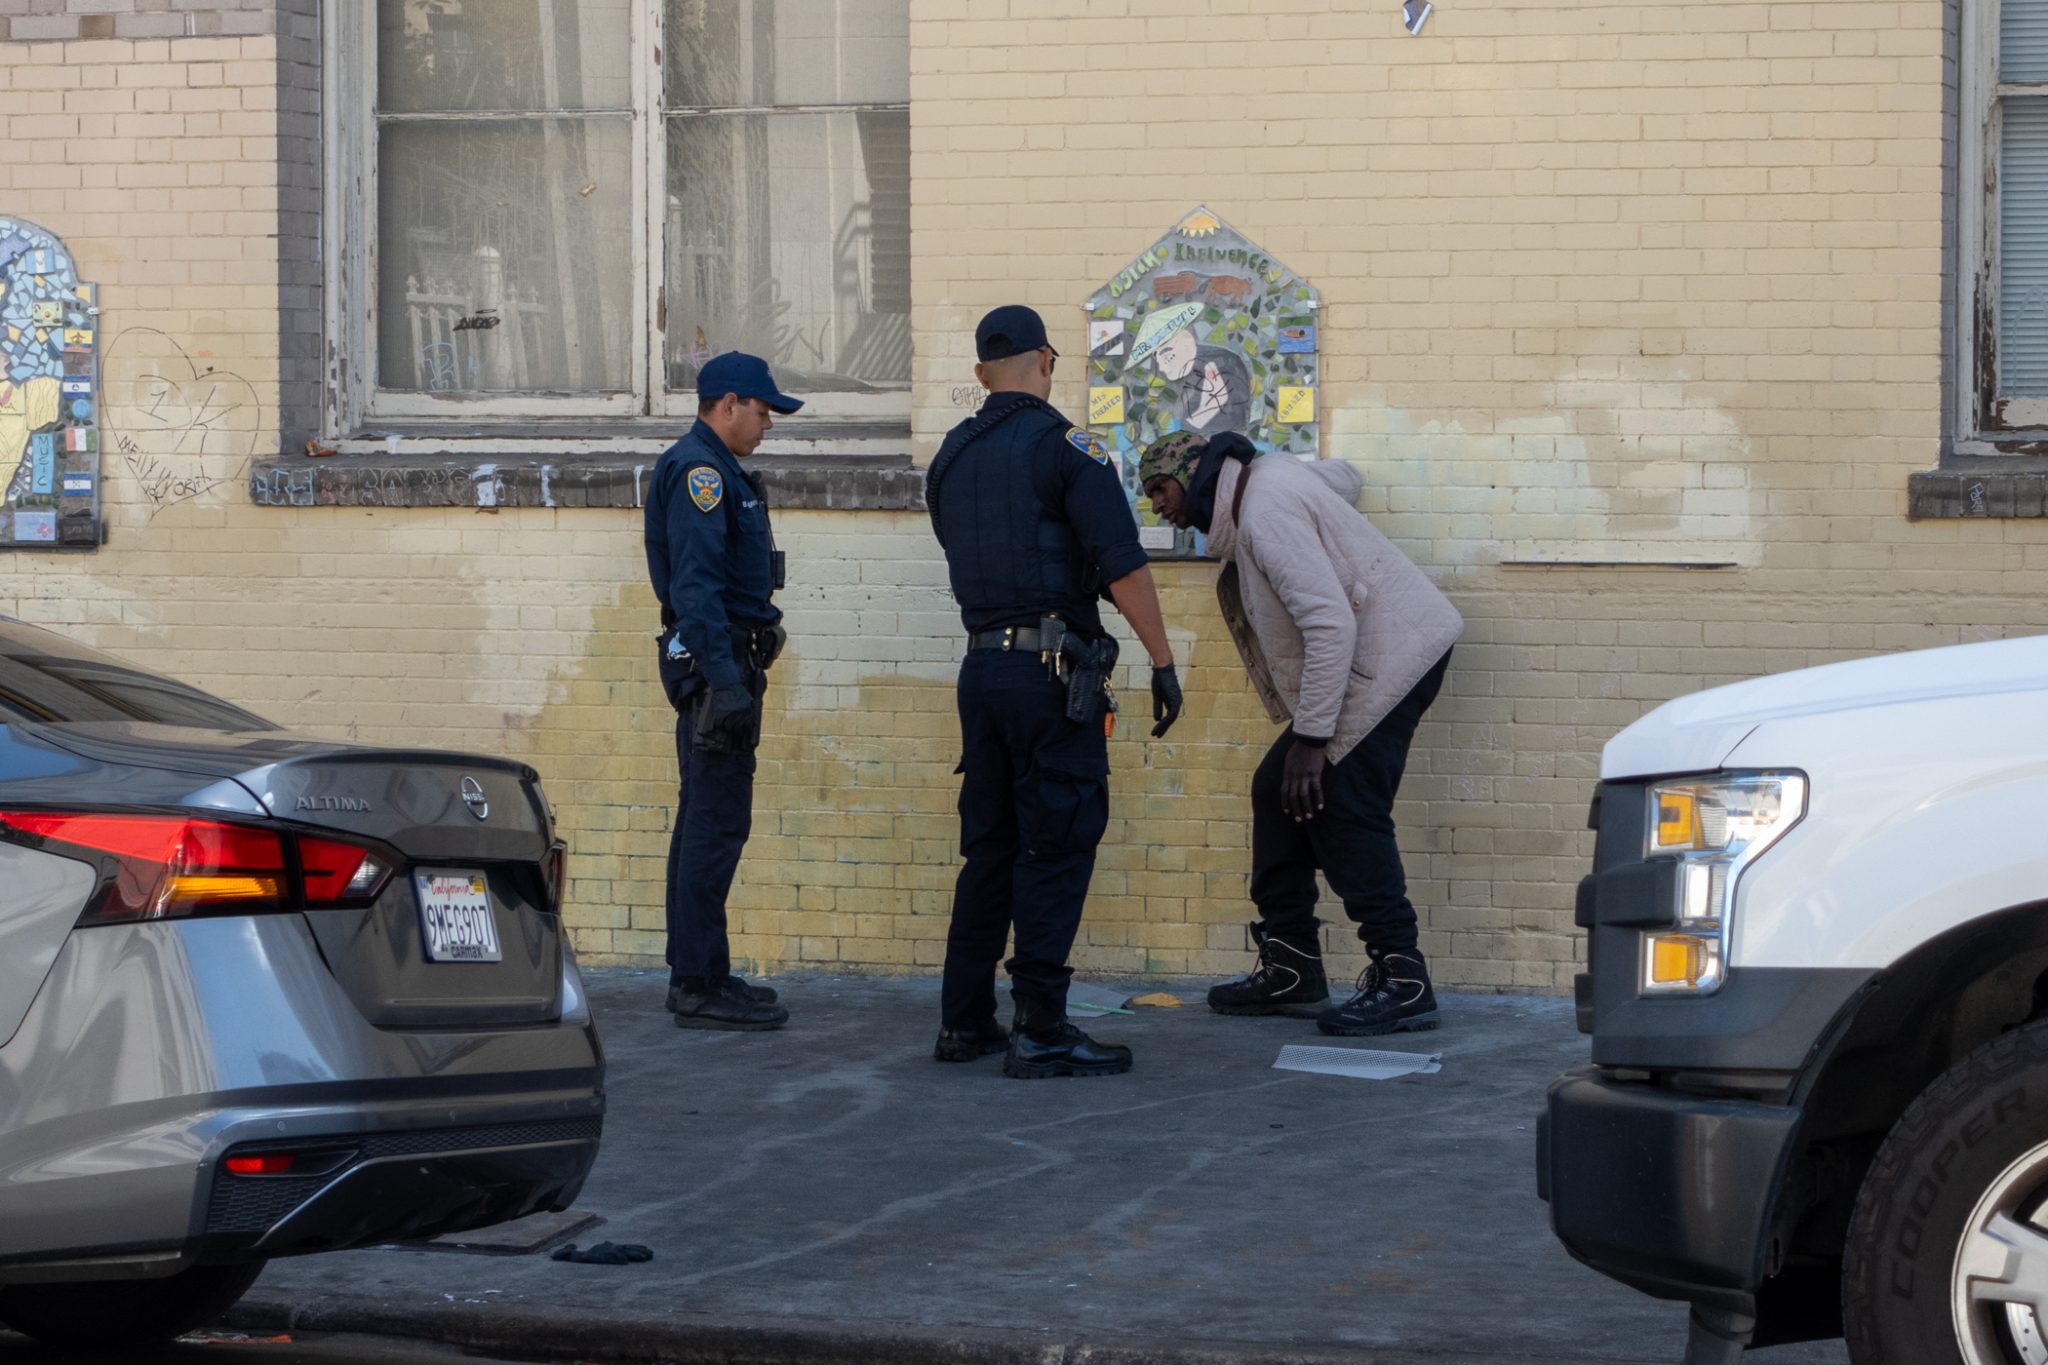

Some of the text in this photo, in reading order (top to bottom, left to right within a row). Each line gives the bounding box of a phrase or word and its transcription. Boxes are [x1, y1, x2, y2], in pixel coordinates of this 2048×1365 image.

[37, 435, 49, 487] MUSIC
[295, 796, 372, 812] ALTIMA
[427, 904, 492, 946] 9MEG907
[1891, 1087, 2028, 1299] COOPER
